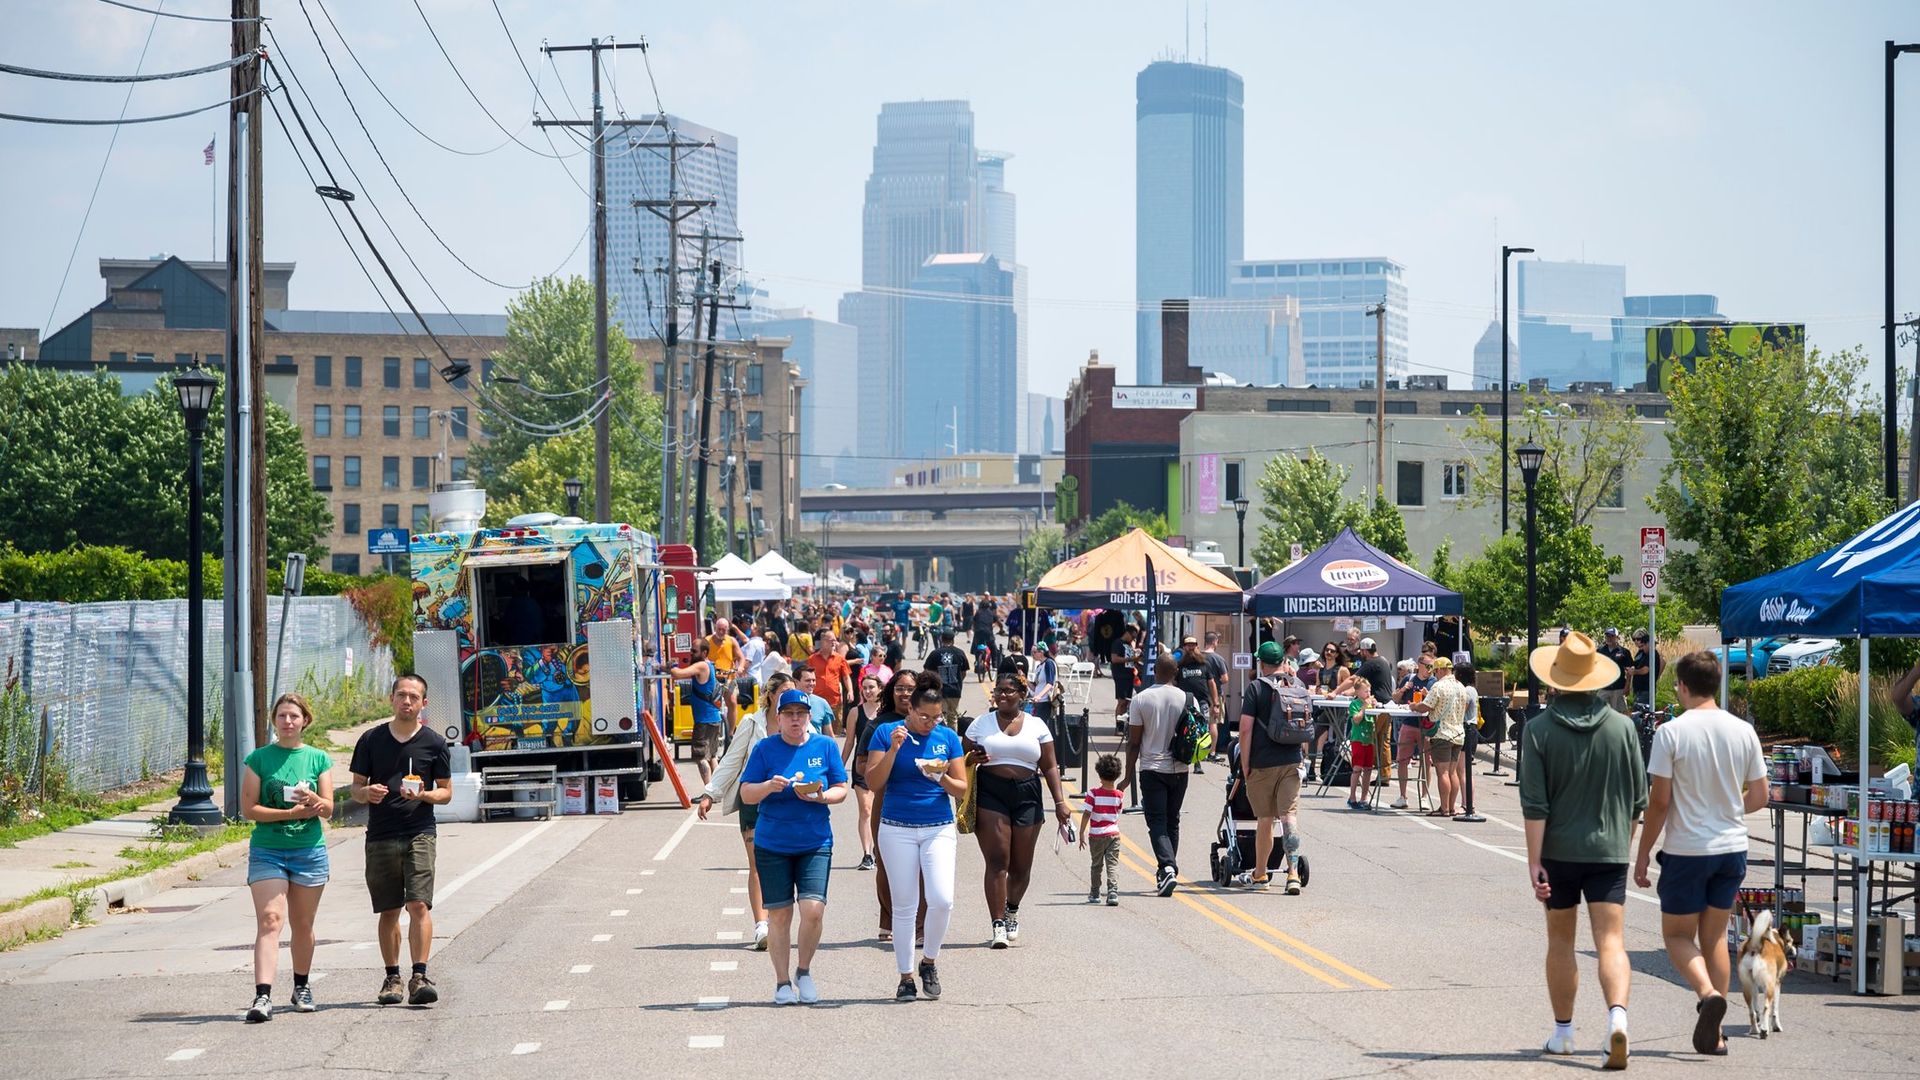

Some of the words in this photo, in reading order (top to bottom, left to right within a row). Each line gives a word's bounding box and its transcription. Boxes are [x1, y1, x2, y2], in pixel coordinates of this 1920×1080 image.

[1135, 390, 1150, 398] FOR
[1152, 390, 1173, 398] LEASE
[1330, 569, 1380, 581] Utepils
[1284, 597, 1393, 613] INDESCRIBABLY
[1398, 597, 1436, 612] GOOD
[933, 744, 947, 754] LSE
[808, 757, 822, 766] LSE
